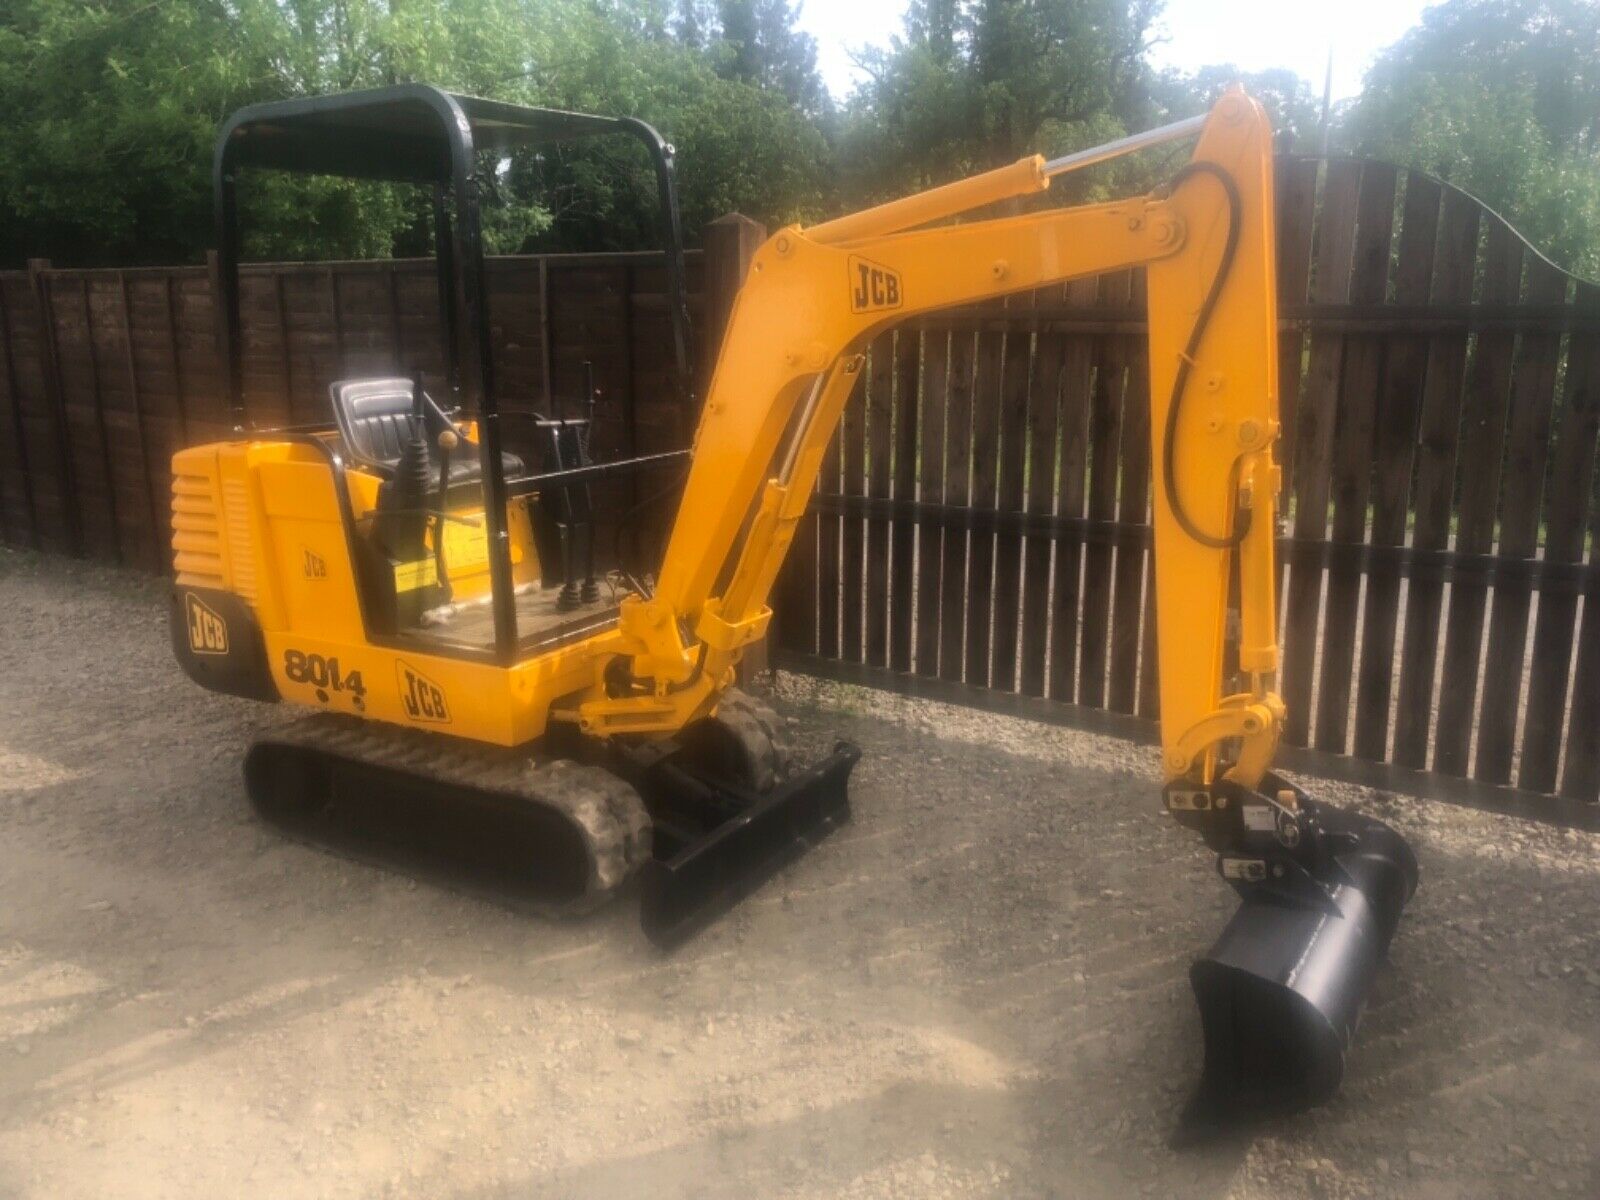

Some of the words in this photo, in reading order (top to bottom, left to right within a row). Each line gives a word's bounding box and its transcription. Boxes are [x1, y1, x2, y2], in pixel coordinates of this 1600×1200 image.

[855, 263, 899, 308] JCB
[304, 550, 326, 577] JCB
[192, 603, 225, 650] JCB
[404, 669, 446, 718] JCB
